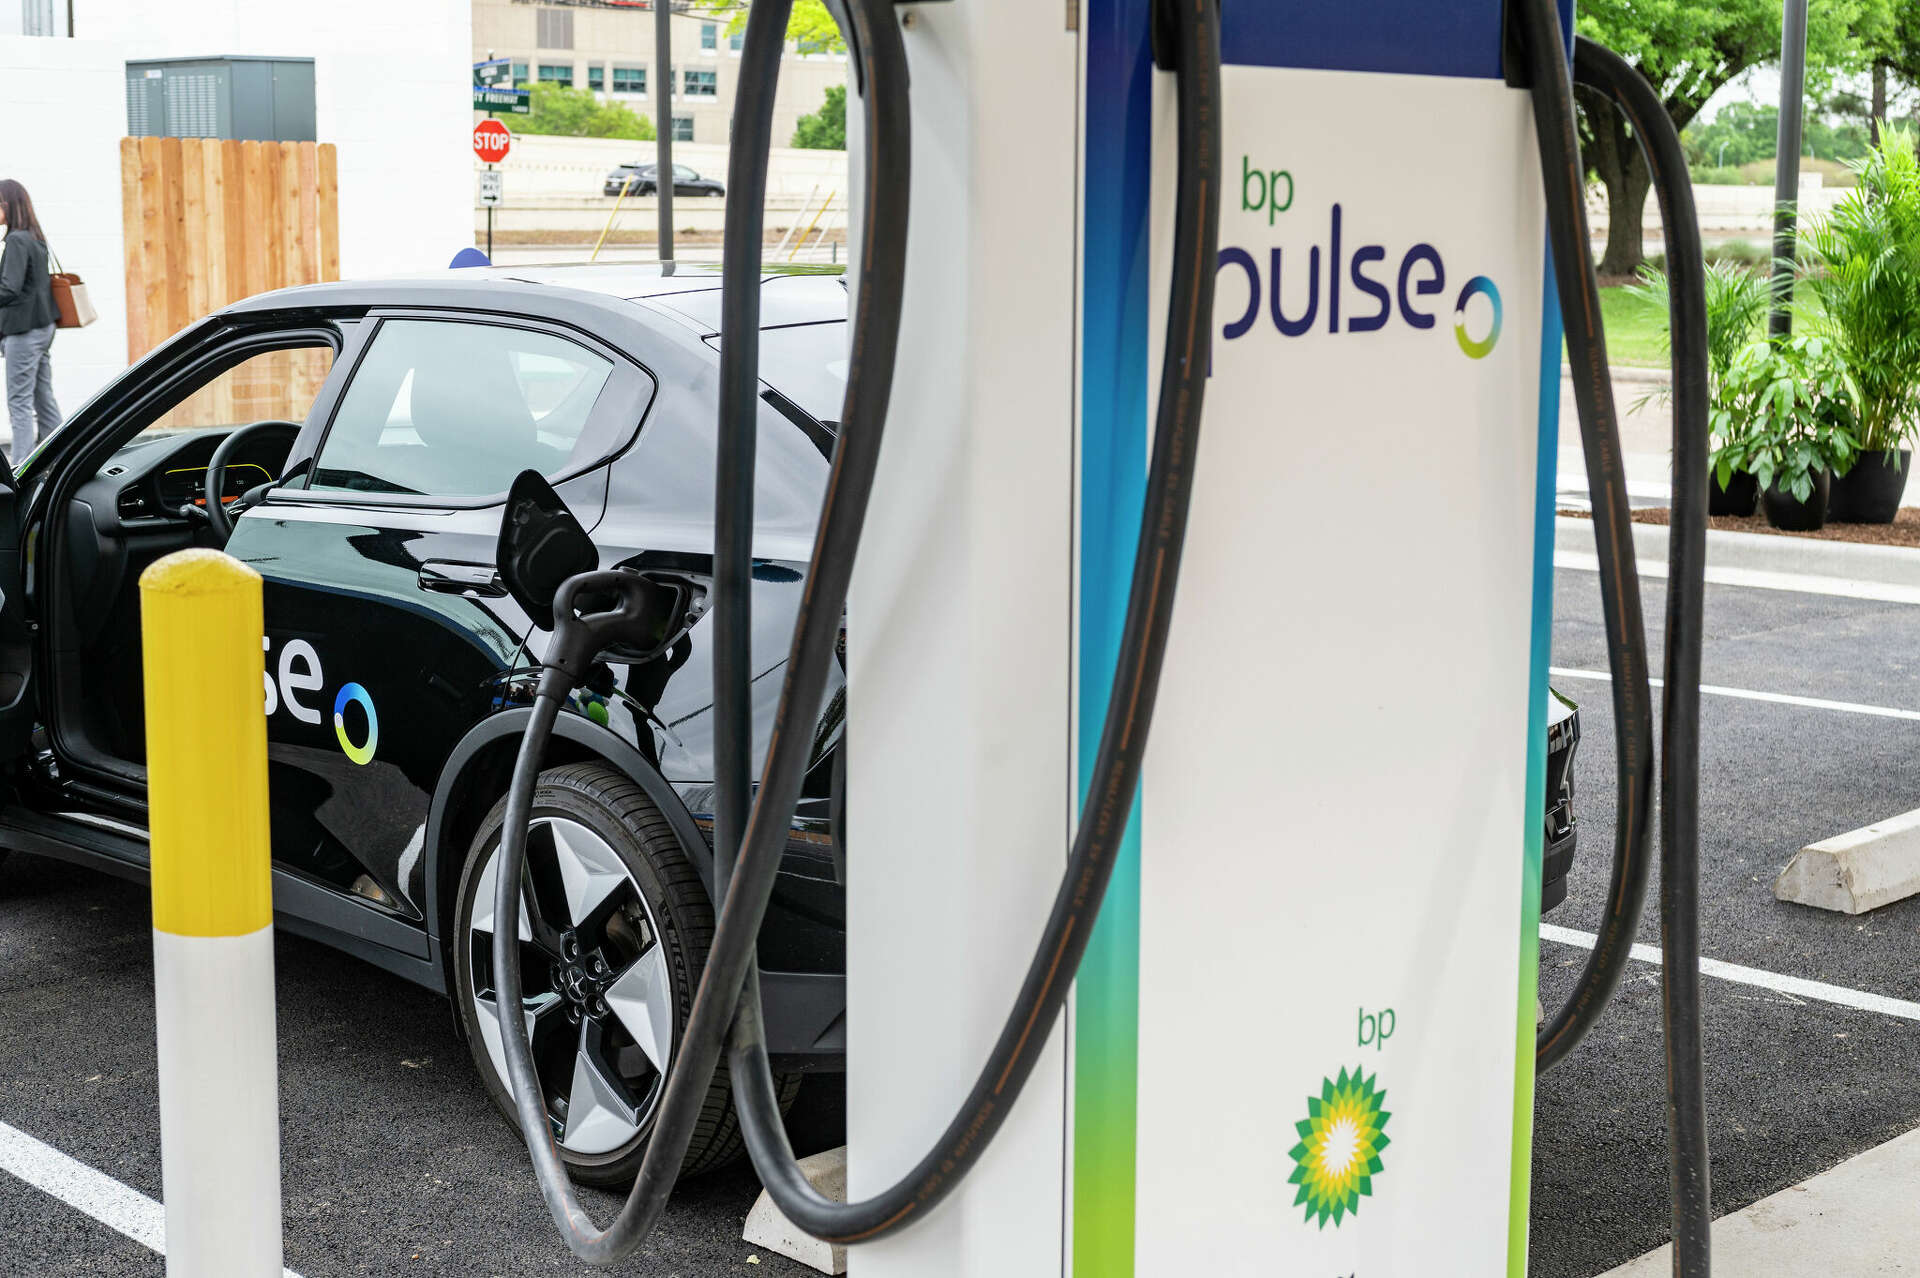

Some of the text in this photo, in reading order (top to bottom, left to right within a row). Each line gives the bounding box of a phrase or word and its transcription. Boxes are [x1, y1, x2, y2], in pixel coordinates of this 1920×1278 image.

[485, 92, 518, 104] FREEWAY
[473, 132, 509, 150] STOP
[482, 174, 499, 182] ONE
[482, 184, 500, 192] WAY
[1242, 155, 1294, 226] bp
[1357, 1006, 1396, 1051] bp
